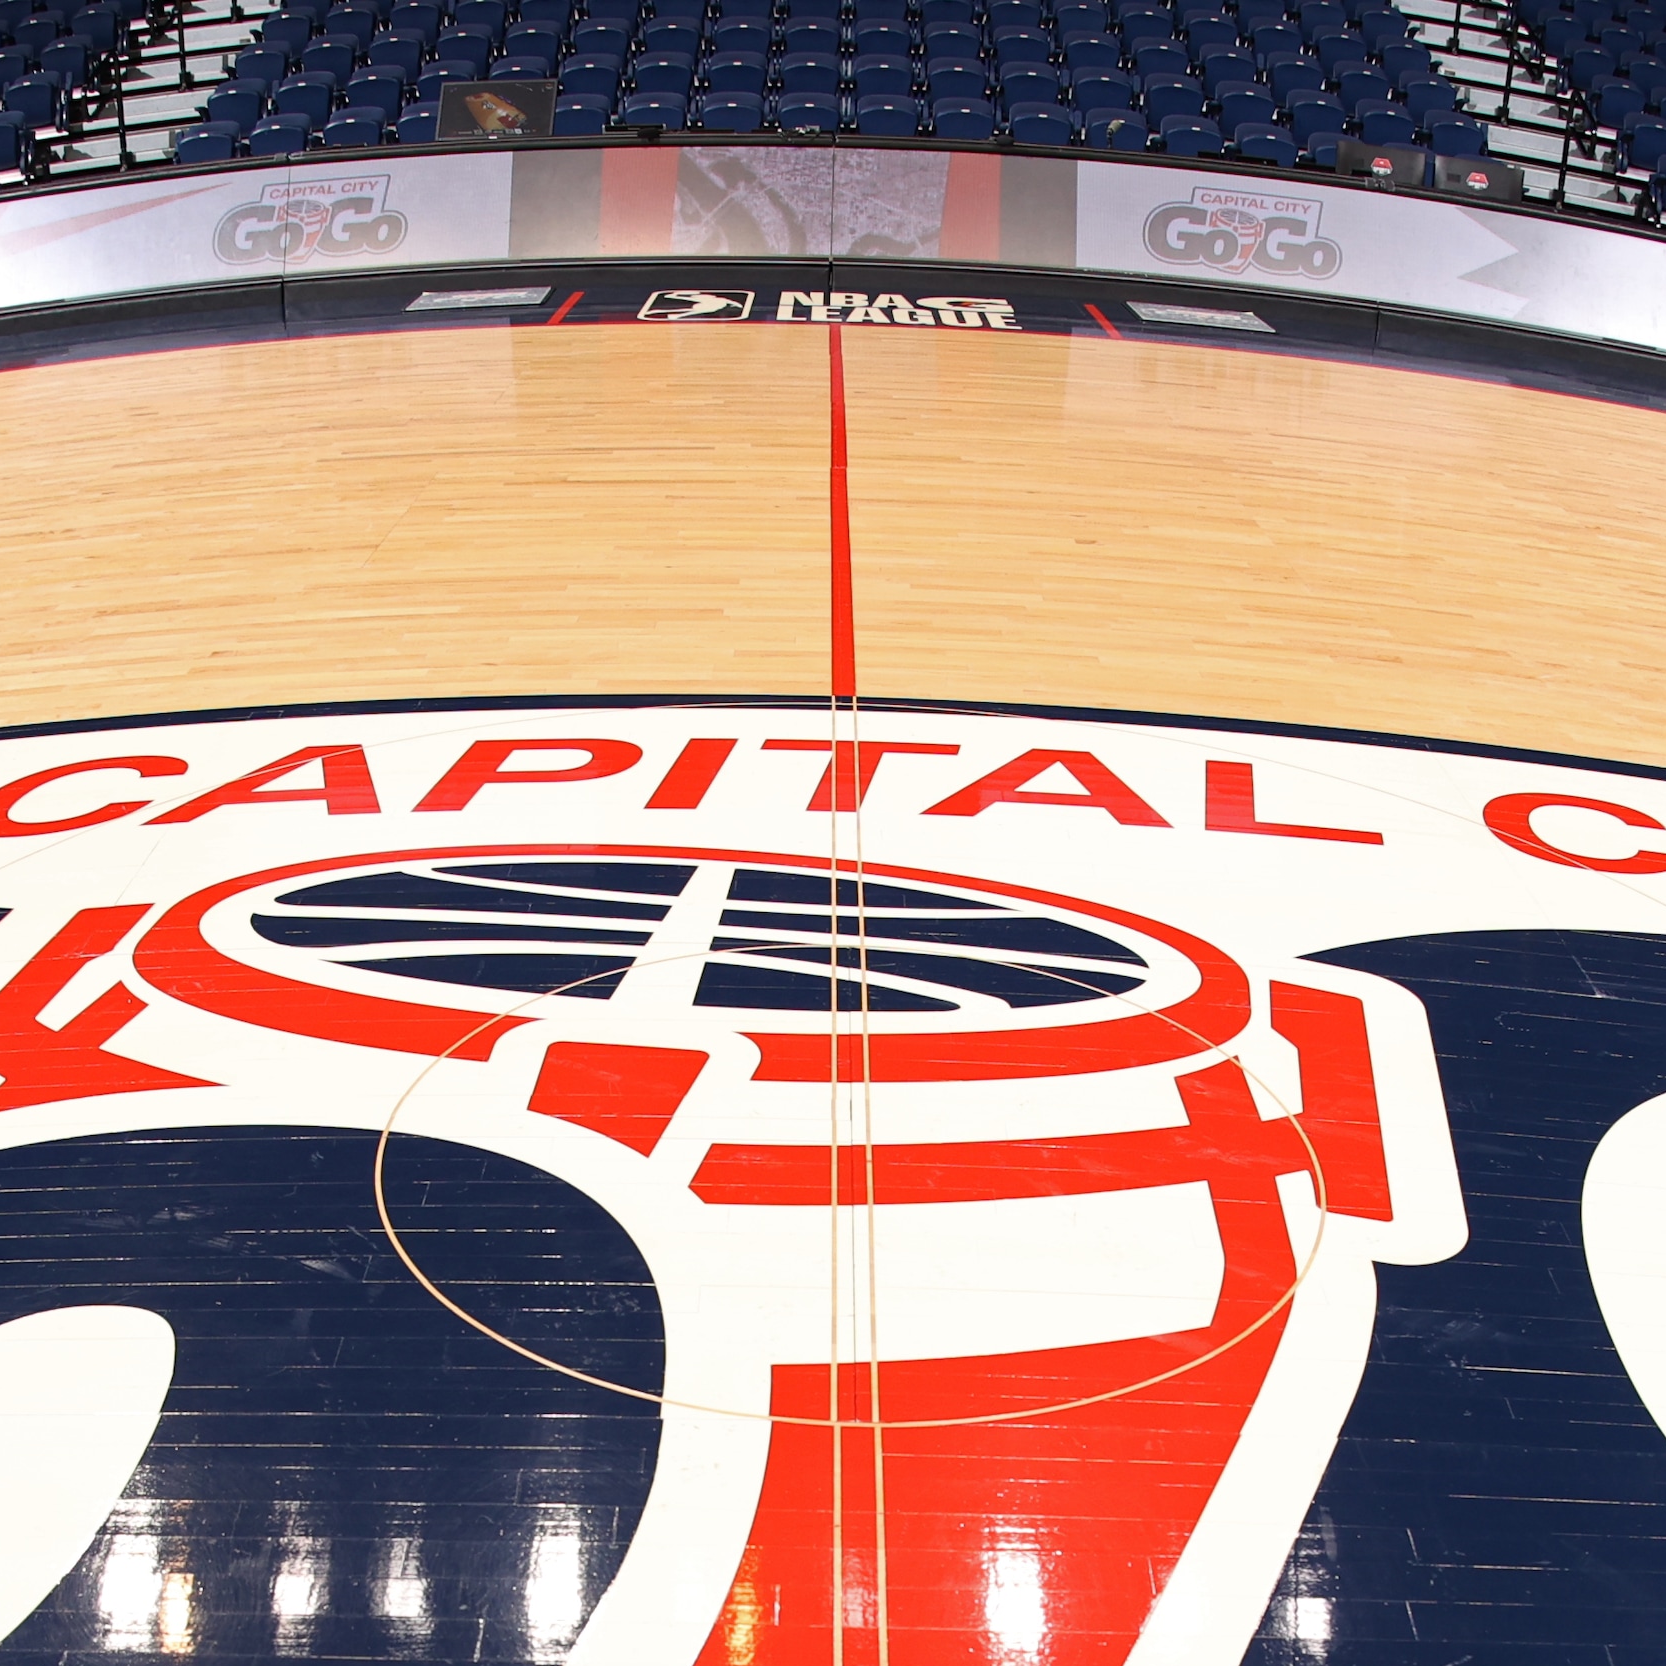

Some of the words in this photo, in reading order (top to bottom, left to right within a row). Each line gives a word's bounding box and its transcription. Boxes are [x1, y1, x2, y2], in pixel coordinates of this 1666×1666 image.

[269, 183, 336, 200] CAPITAL
[341, 180, 380, 194] CITY
[1200, 192, 1269, 211] CAPITAL
[1274, 201, 1311, 215] CITY
[778, 291, 916, 309] NBA
[776, 305, 1023, 330] LEAGUE
